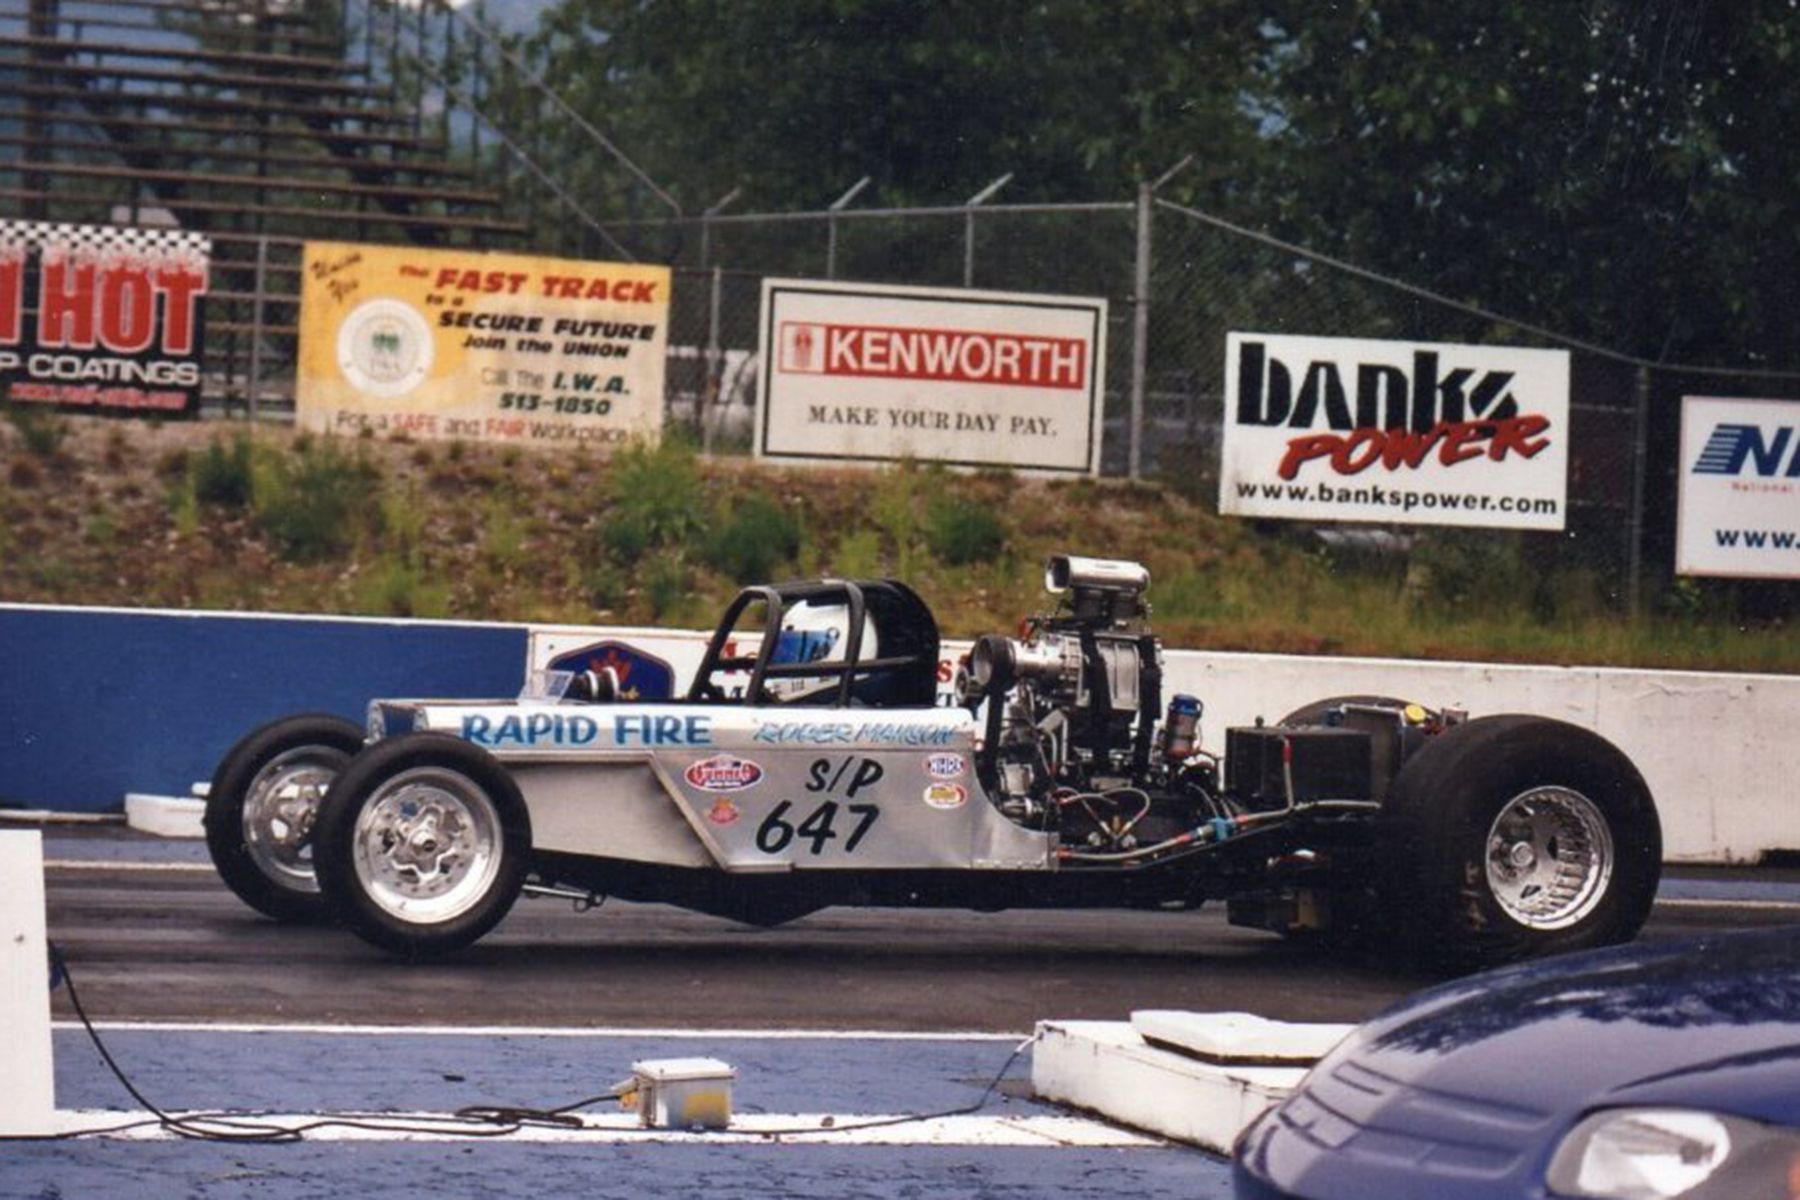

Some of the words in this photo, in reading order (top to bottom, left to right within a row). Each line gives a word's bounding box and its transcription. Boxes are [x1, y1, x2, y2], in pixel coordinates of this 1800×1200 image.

[38, 243, 208, 354] HOT
[436, 268, 528, 294] FAST
[542, 275, 657, 304] TRACK
[439, 310, 543, 333] SECURE
[553, 318, 656, 341] FUTURE
[462, 335, 507, 350] Join
[516, 337, 553, 352] the
[563, 340, 630, 358] UNION
[830, 329, 1081, 384] KENWORTH
[28, 354, 199, 386] COATINGS
[552, 370, 631, 395] I.W.A.
[498, 391, 612, 415] 513-1850
[393, 413, 437, 432] SAFE
[445, 416, 480, 437] and
[486, 418, 525, 437] FAIR
[531, 420, 627, 444] Workplace
[808, 405, 879, 426] MAKE
[888, 409, 949, 430] YOUR
[956, 412, 1001, 433] DAY
[1010, 416, 1057, 437] PAY.
[1277, 414, 1551, 481] POWER
[1236, 481, 1557, 513] www.bankspower.com
[461, 713, 598, 745] RAPID
[614, 714, 712, 745] FIRE
[805, 756, 884, 798] S/P
[755, 800, 880, 855] 647
